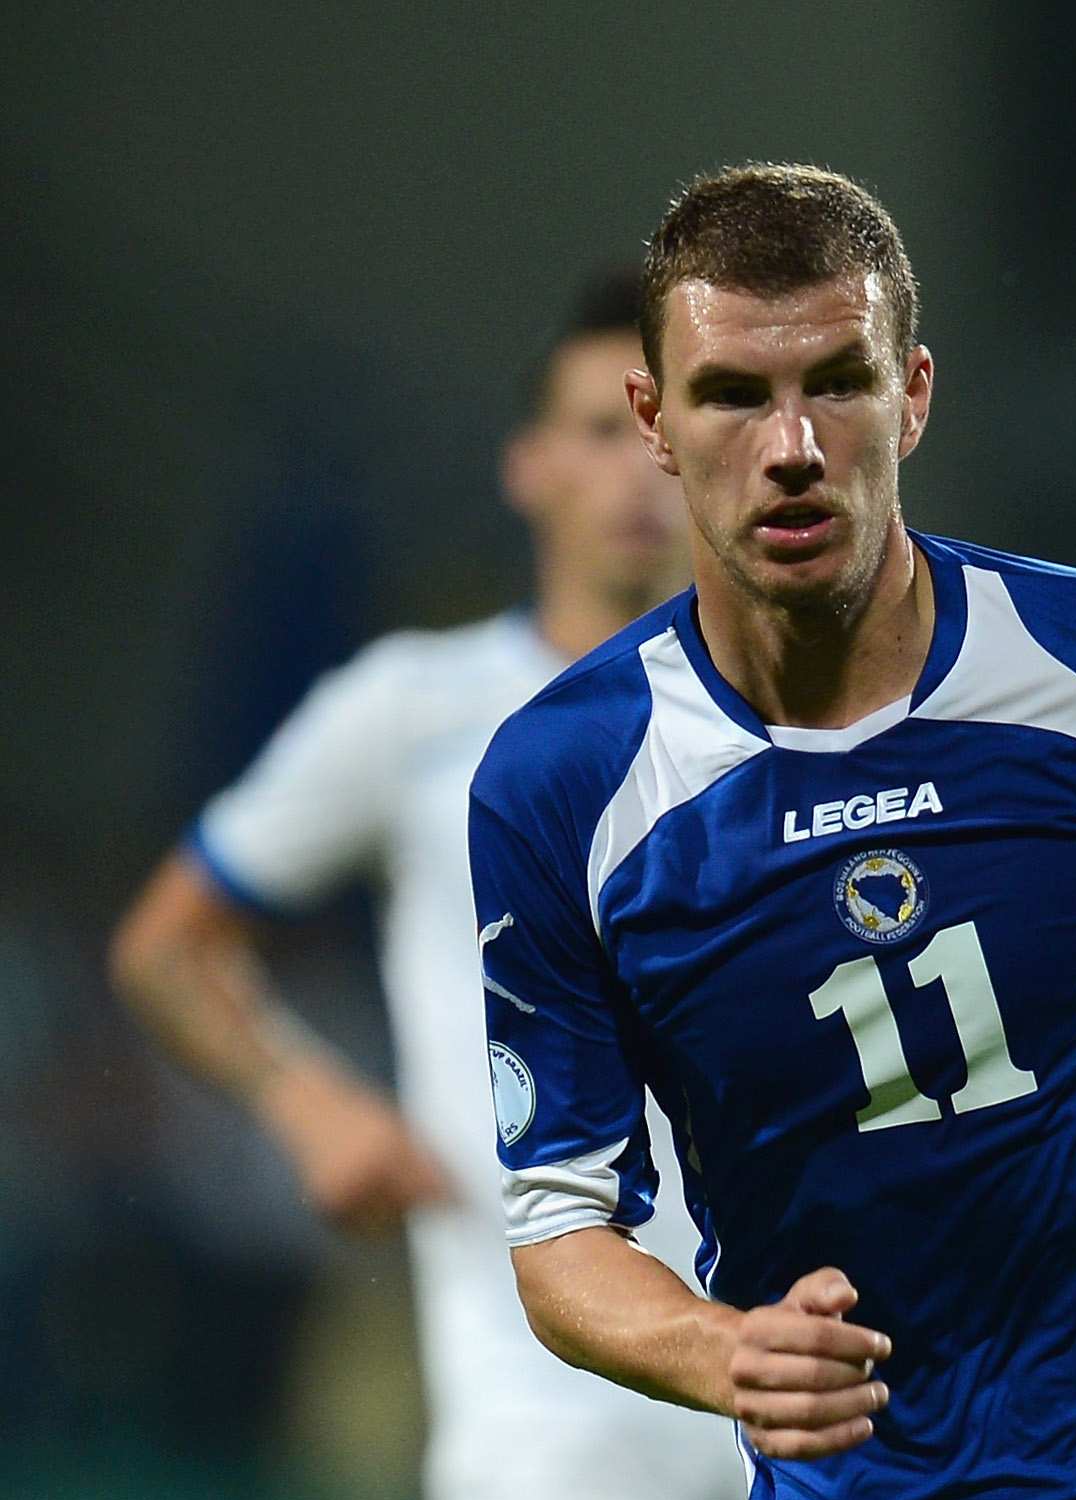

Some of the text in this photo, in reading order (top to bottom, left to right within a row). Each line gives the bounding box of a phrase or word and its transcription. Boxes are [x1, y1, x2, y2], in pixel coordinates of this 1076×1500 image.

[783, 781, 943, 843] LEGEA
[836, 865, 851, 901] BOSNIA
[845, 916, 886, 941] FOOTBALL
[808, 920, 1039, 1134] 11
[504, 1057, 527, 1089] BRAZIL
